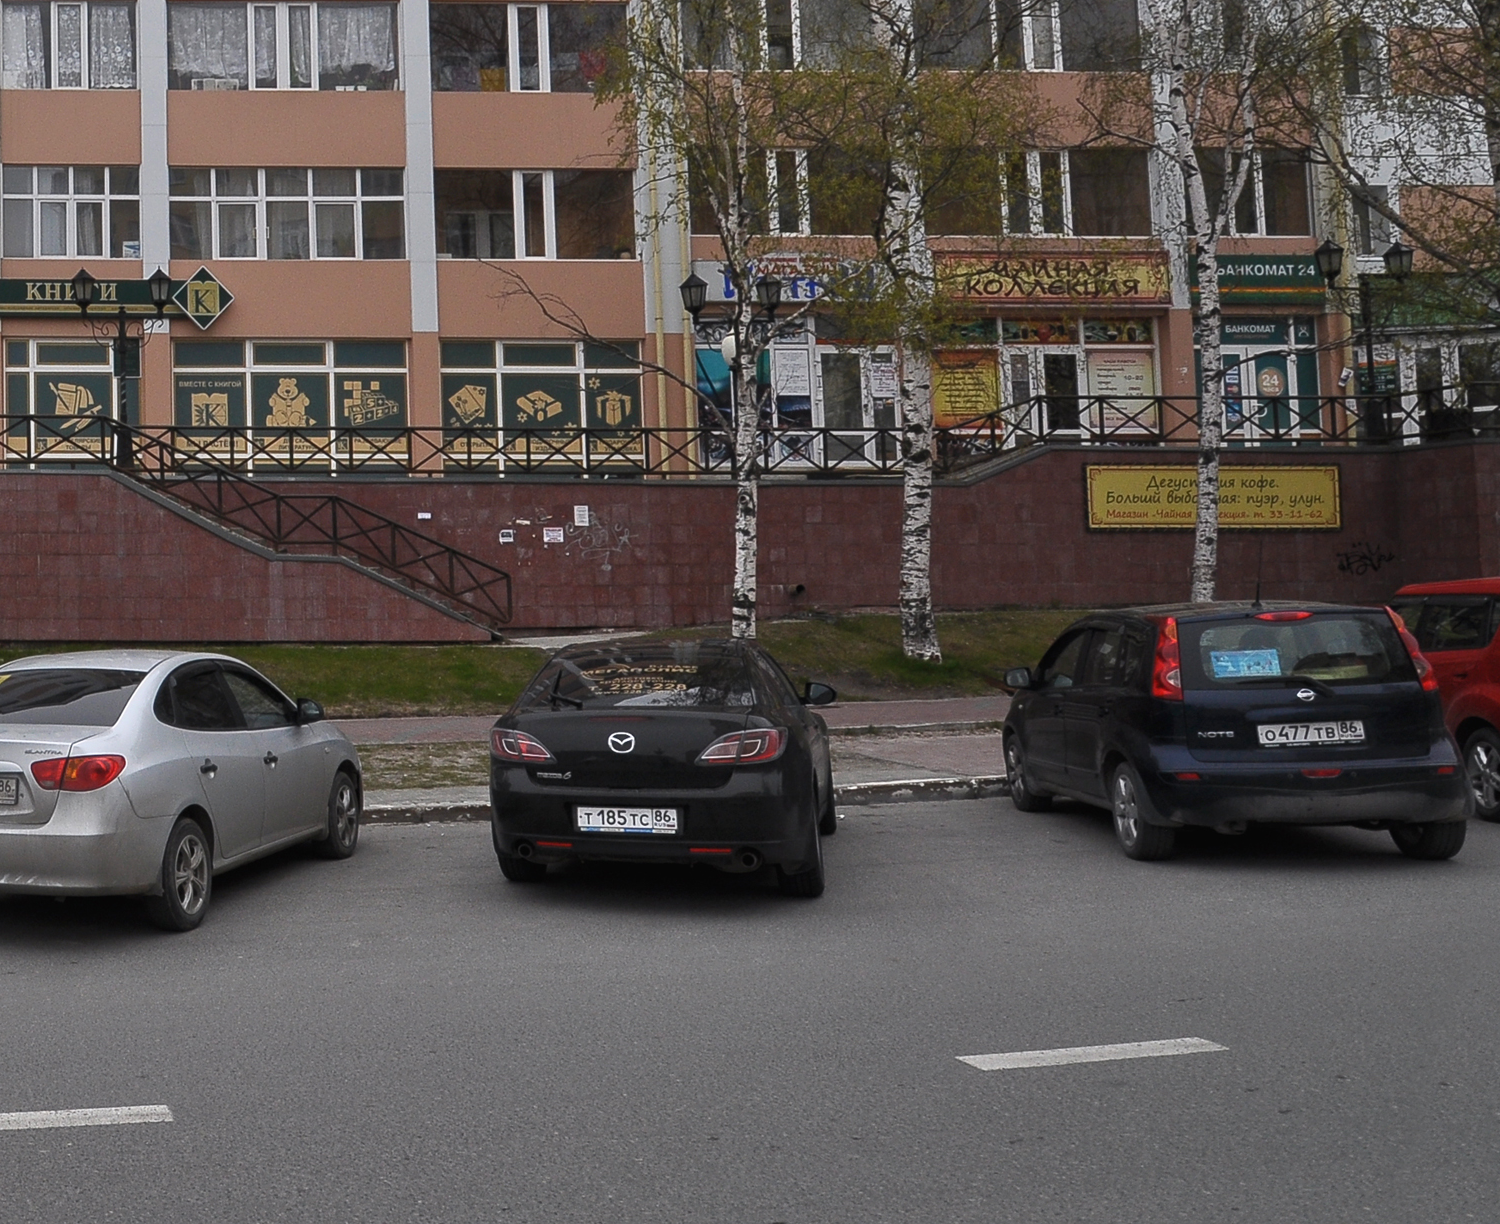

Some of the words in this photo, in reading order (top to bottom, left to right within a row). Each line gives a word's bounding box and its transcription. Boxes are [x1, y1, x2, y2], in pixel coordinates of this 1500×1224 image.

[1298, 264, 1316, 276] 24
[25, 282, 118, 301] КНИИ
[966, 278, 1141, 297] КОЛЛЕКЦИЯ
[1225, 324, 1276, 333] БАНКОМАТ
[1261, 374, 1279, 386] 24
[1241, 474, 1280, 493] кофе.
[1246, 495, 1285, 509] пуэр,
[1289, 495, 1326, 508] улун.
[1106, 509, 1150, 519] Магазин
[1269, 510, 1323, 519] 33-11-62
[580, 667, 698, 676] МЕГАПОЛИС
[609, 683, 688, 691] 228-228
[1340, 722, 1359, 735] 86
[654, 810, 672, 823] 86
